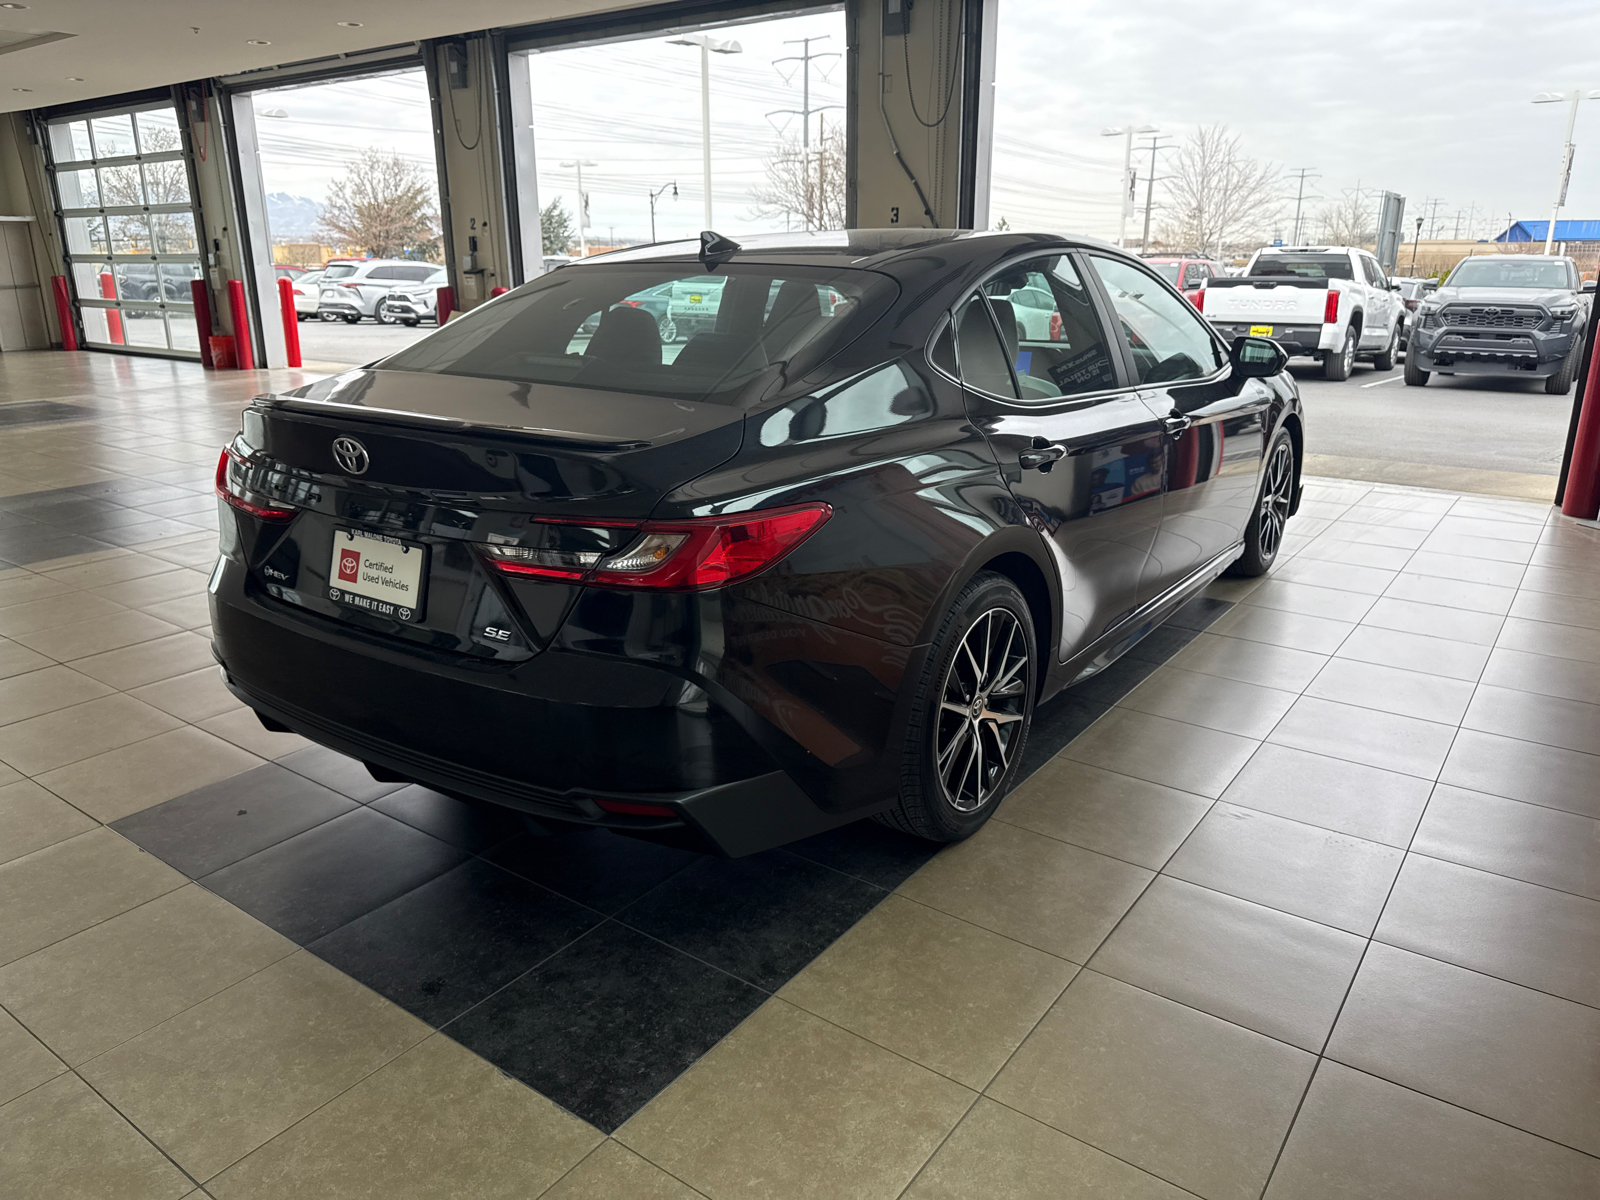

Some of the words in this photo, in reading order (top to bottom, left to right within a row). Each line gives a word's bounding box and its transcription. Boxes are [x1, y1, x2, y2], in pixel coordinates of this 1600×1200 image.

[891, 207, 899, 223] 3
[470, 217, 476, 230] 2
[1228, 299, 1298, 310] TUNDRA
[351, 528, 363, 537] KARL
[363, 558, 394, 574] Certified
[362, 571, 379, 584] Used
[380, 575, 409, 592] Vehicles
[344, 593, 354, 604] WE
[354, 595, 371, 609] MAKE
[371, 600, 378, 611] IT
[378, 603, 395, 615] EASY
[483, 626, 512, 641] SE
[934, 629, 960, 693] Continental
